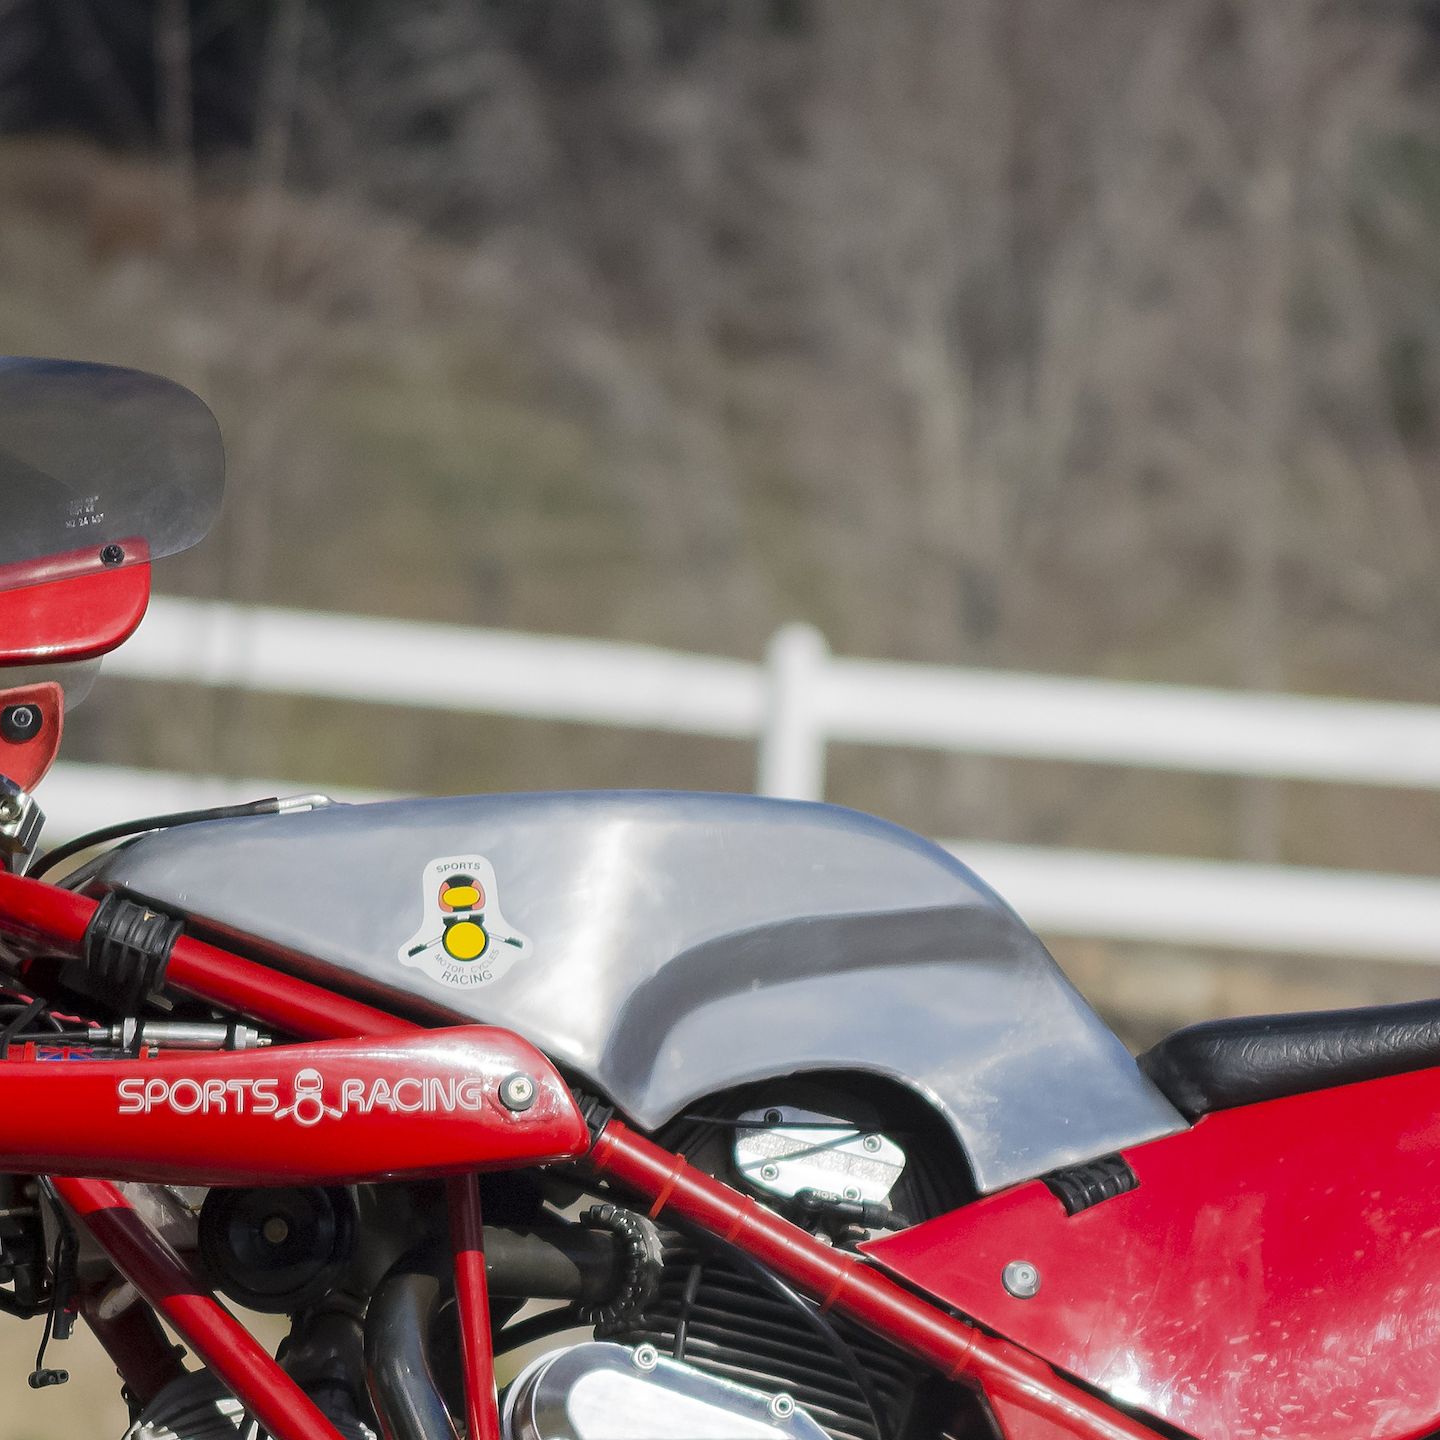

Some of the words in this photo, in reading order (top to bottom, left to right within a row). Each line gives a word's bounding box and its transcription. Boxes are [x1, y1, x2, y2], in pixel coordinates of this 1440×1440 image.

[436, 862, 481, 873] SPORTS
[434, 953, 465, 973] MOTOR
[441, 969, 493, 985] RACING
[118, 1078, 278, 1114] SPORTS
[340, 1077, 482, 1112] RACING
